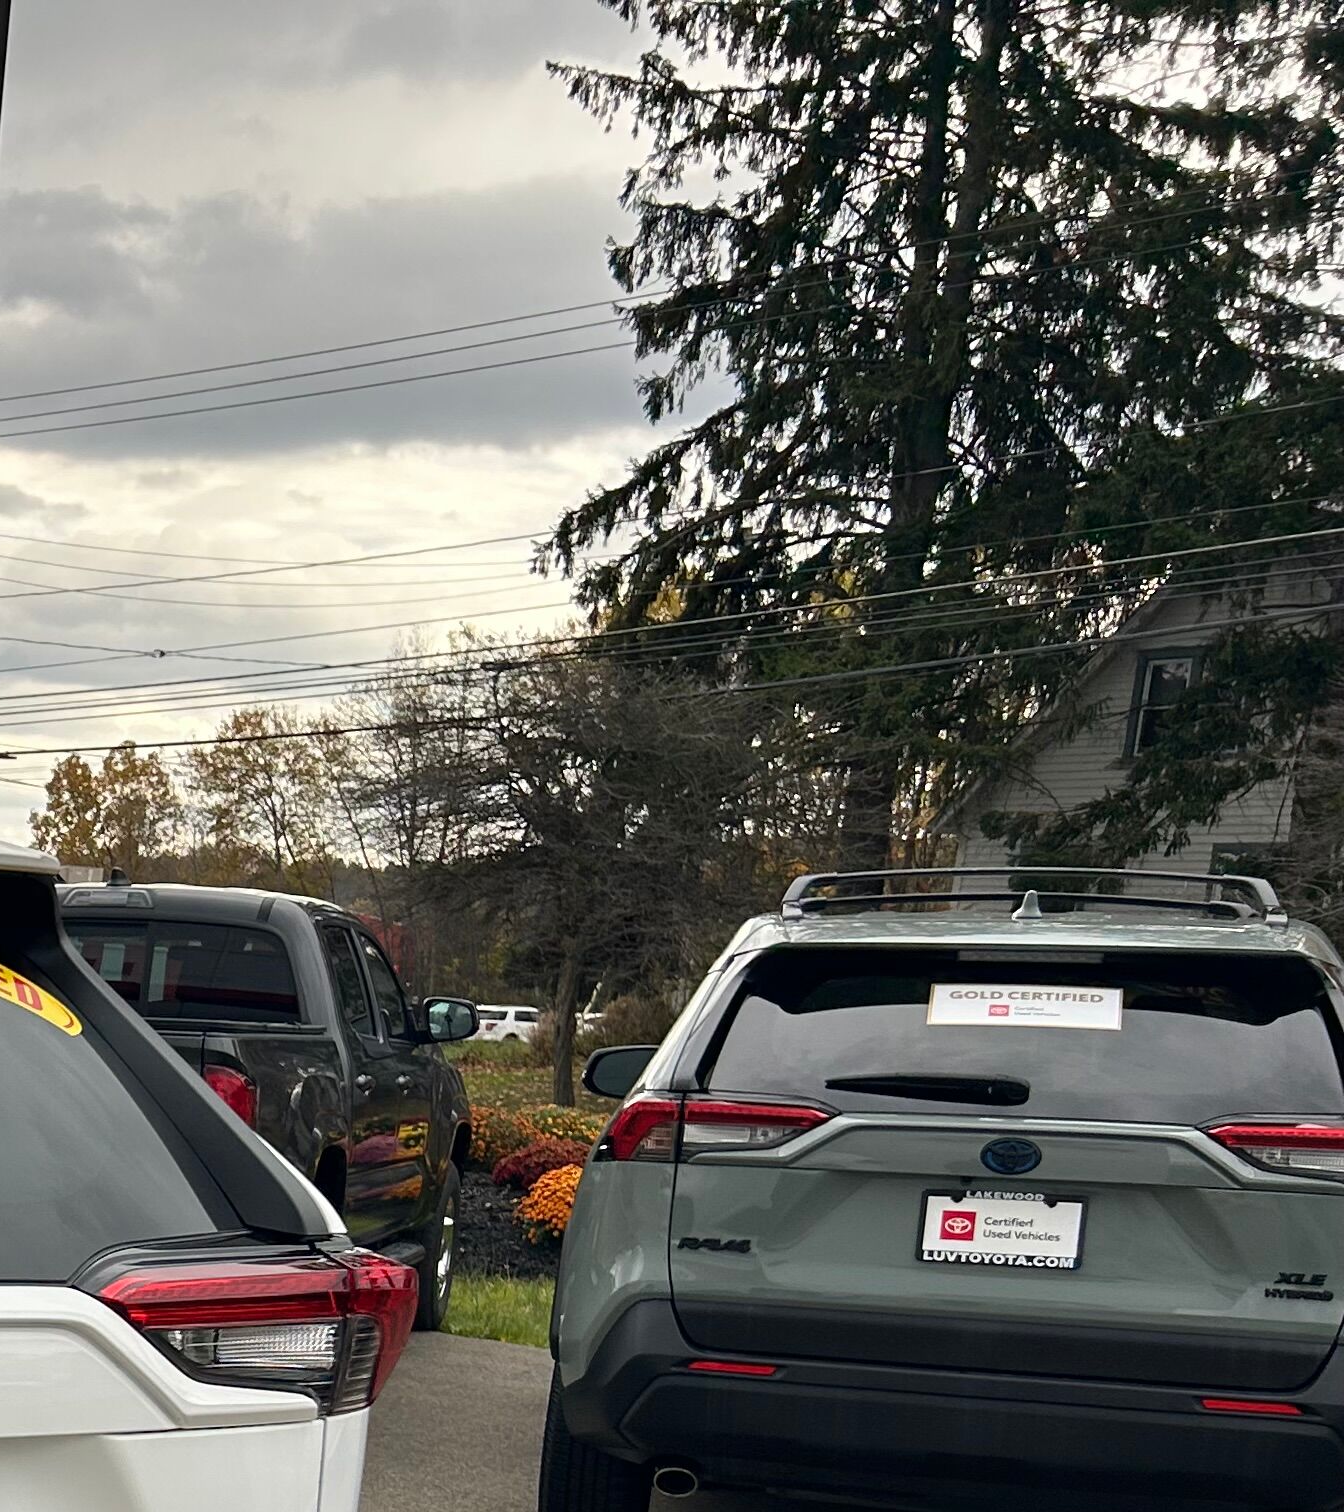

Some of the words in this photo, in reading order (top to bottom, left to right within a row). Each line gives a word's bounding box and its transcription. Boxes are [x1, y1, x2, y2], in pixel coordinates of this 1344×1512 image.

[949, 990, 1003, 1000] GOLD
[1007, 991, 1104, 1003] CERTIFIED
[966, 1190, 1045, 1201] LAKEWOOD
[984, 1217, 1033, 1228] Certified
[983, 1229, 1011, 1239] Used
[1015, 1231, 1061, 1242] Vehicles
[923, 1250, 1075, 1269] LUVTOYOTA.COM
